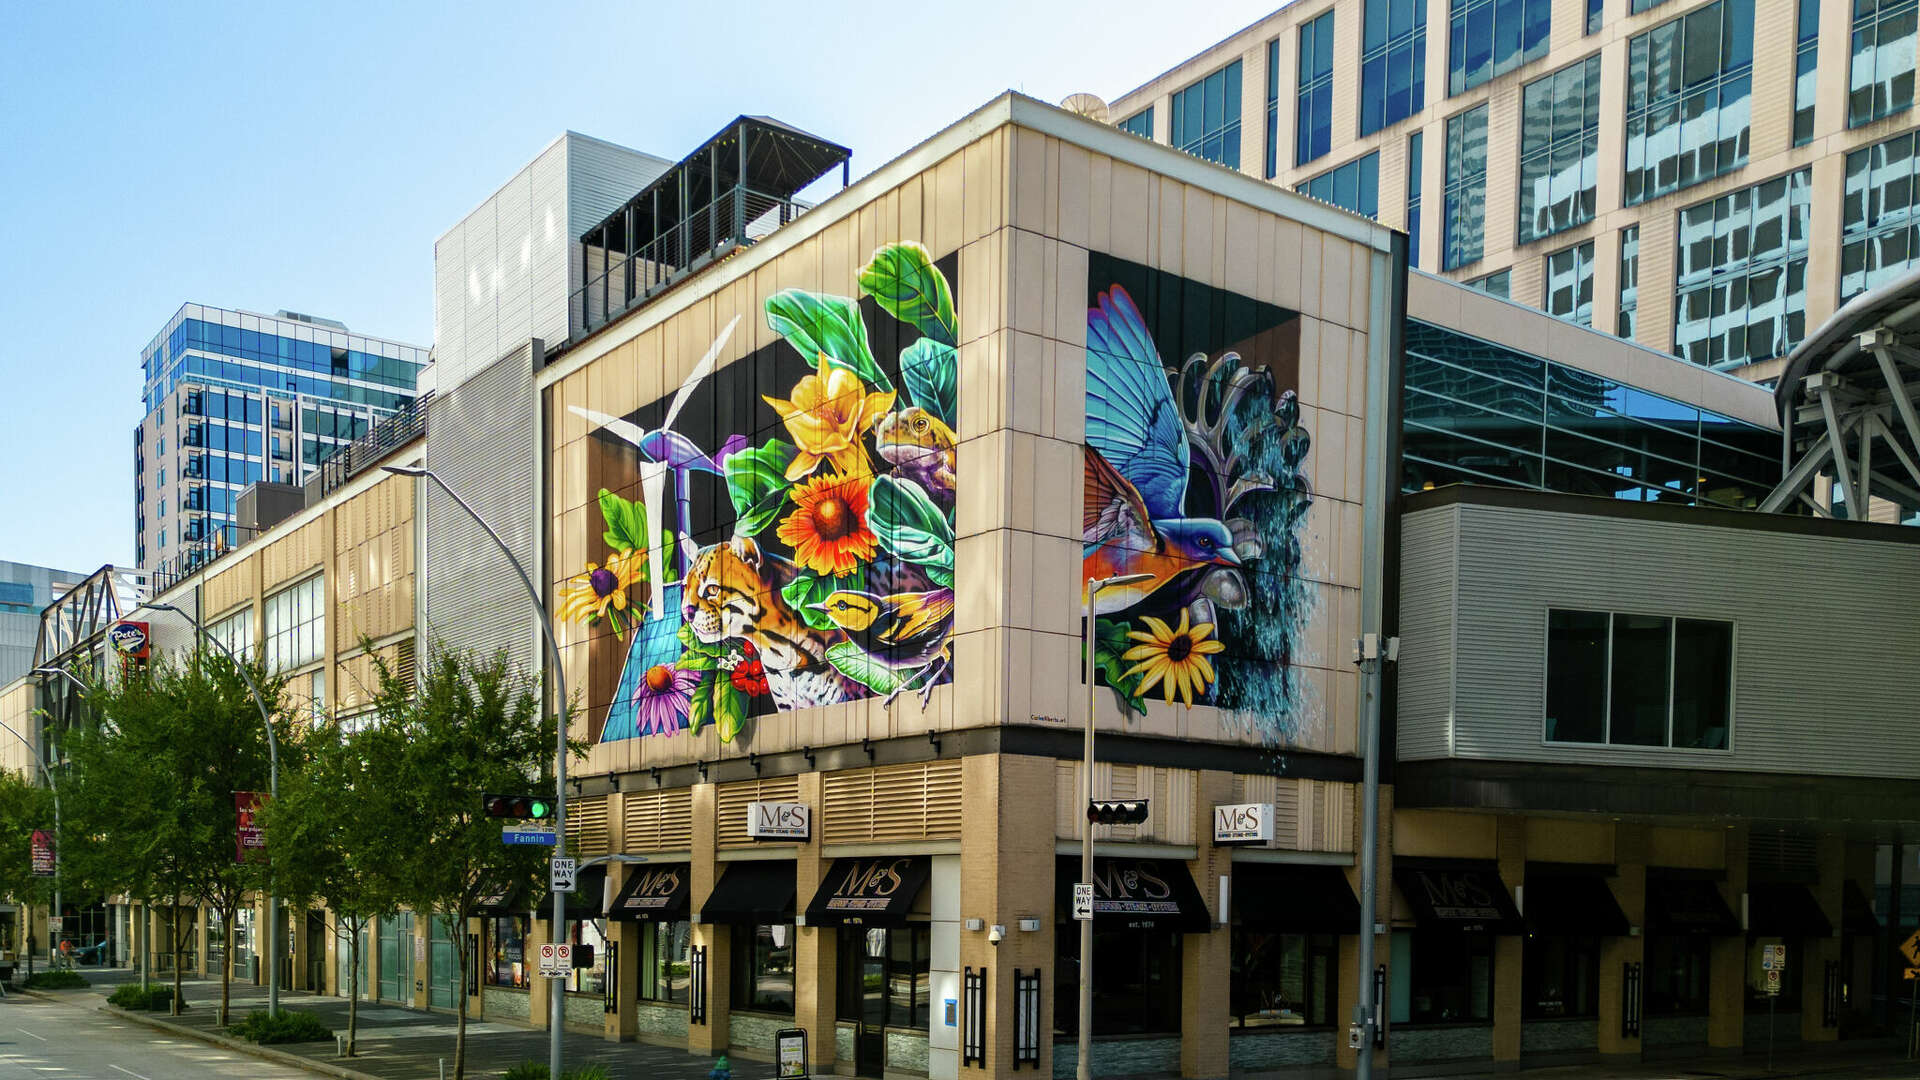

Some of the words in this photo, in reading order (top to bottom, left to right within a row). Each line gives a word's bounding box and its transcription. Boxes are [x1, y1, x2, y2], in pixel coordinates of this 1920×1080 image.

[760, 805, 805, 828] M&S
[1218, 806, 1259, 831] M&S
[514, 833, 545, 843] Fannin
[554, 860, 574, 869] ONE
[554, 870, 574, 879] WAY
[834, 859, 912, 895] M&S
[631, 870, 680, 896] M&S
[1076, 886, 1092, 896] ONE
[1075, 896, 1092, 905] WAY
